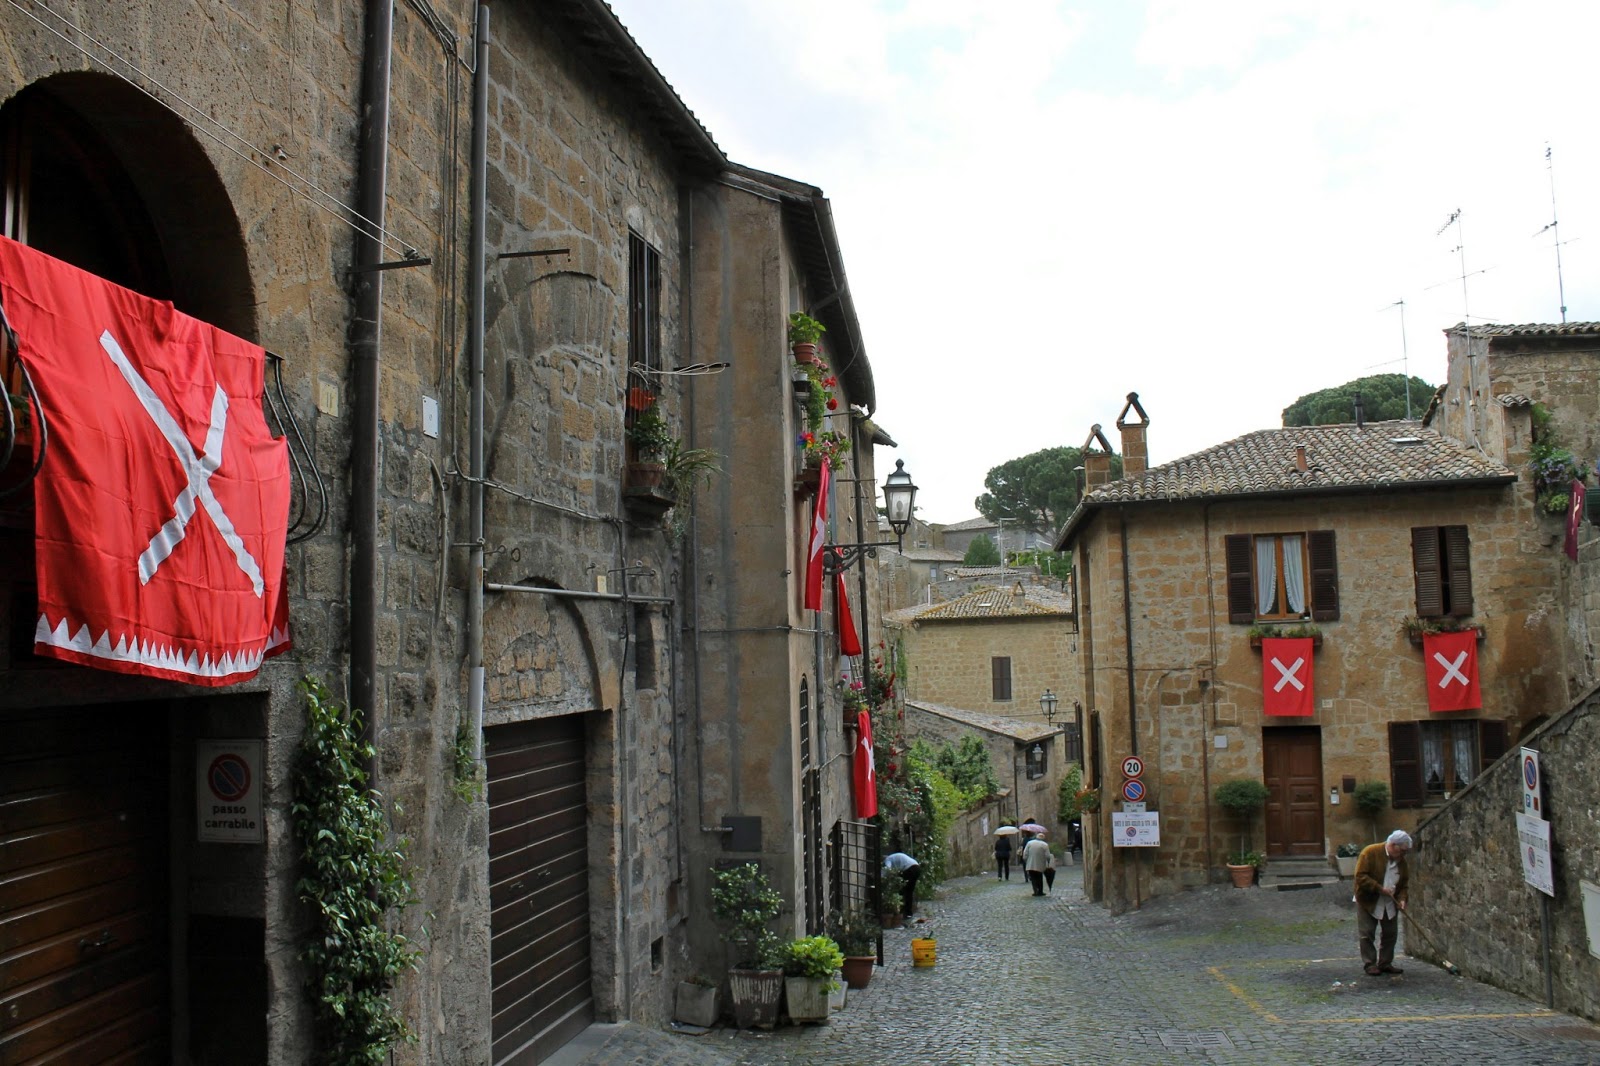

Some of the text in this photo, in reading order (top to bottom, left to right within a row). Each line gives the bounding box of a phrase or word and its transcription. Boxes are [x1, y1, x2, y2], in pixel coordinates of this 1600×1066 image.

[1127, 763, 1139, 773] 20
[212, 805, 246, 815] passo
[205, 819, 255, 829] carrabile
